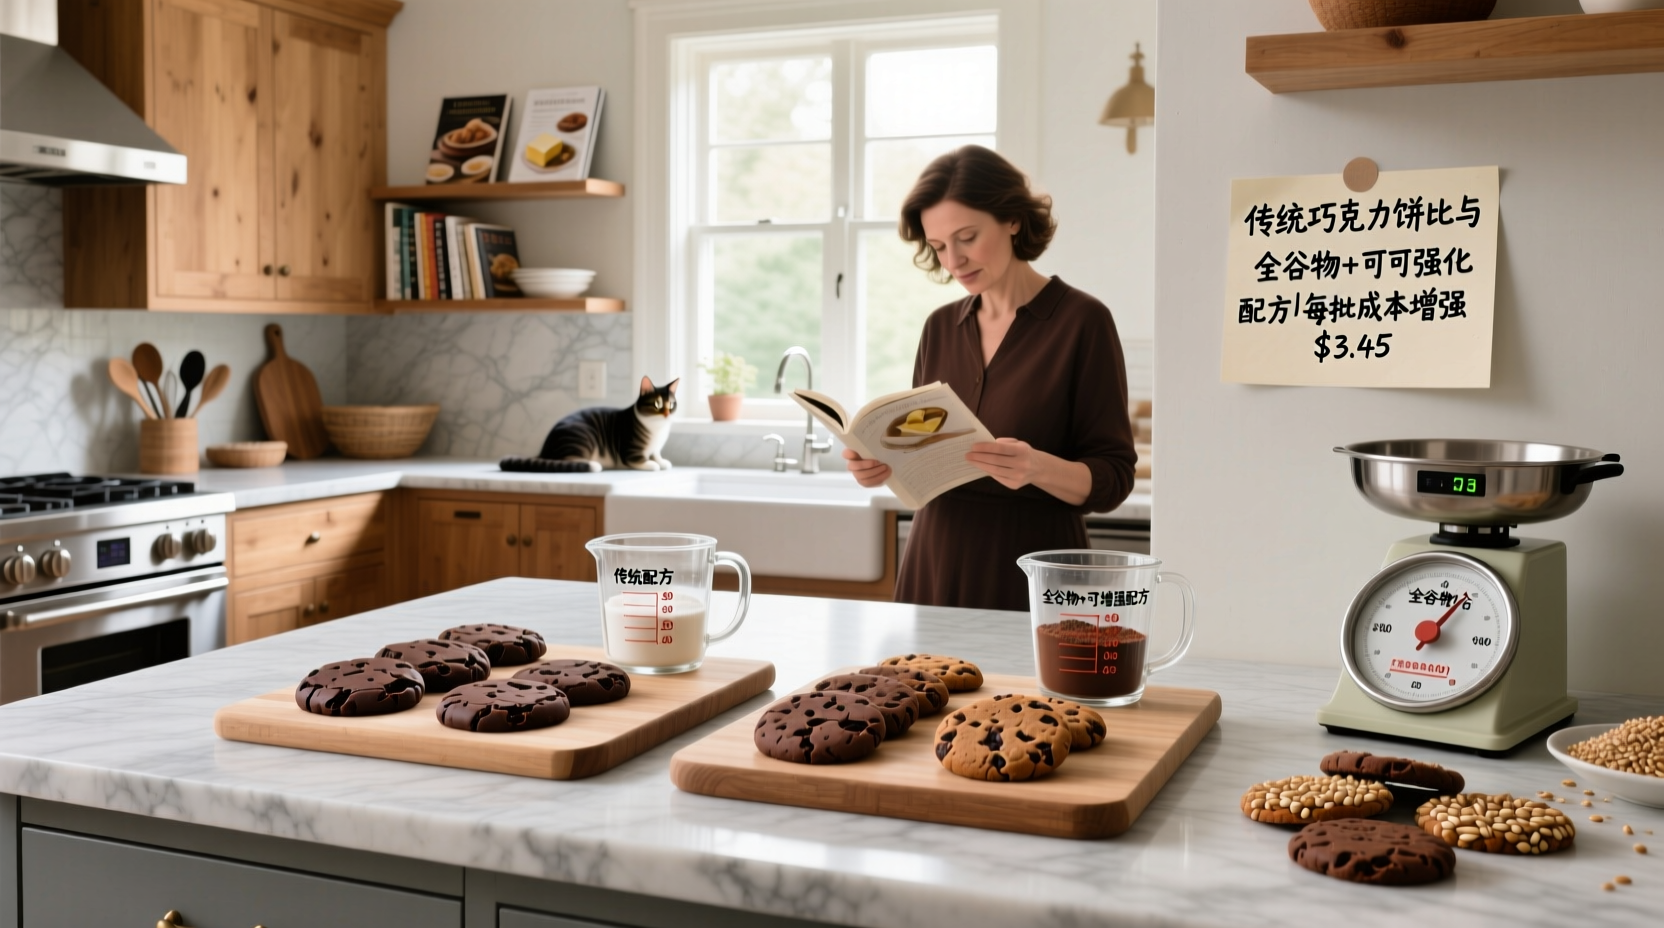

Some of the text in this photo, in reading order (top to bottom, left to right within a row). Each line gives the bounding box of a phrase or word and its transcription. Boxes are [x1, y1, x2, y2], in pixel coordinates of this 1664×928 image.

[1244, 195, 1481, 237] 传统巧克力饼比与
[1254, 247, 1474, 282] 全谷物+可可强化
[1314, 330, 1393, 363] $3.45
